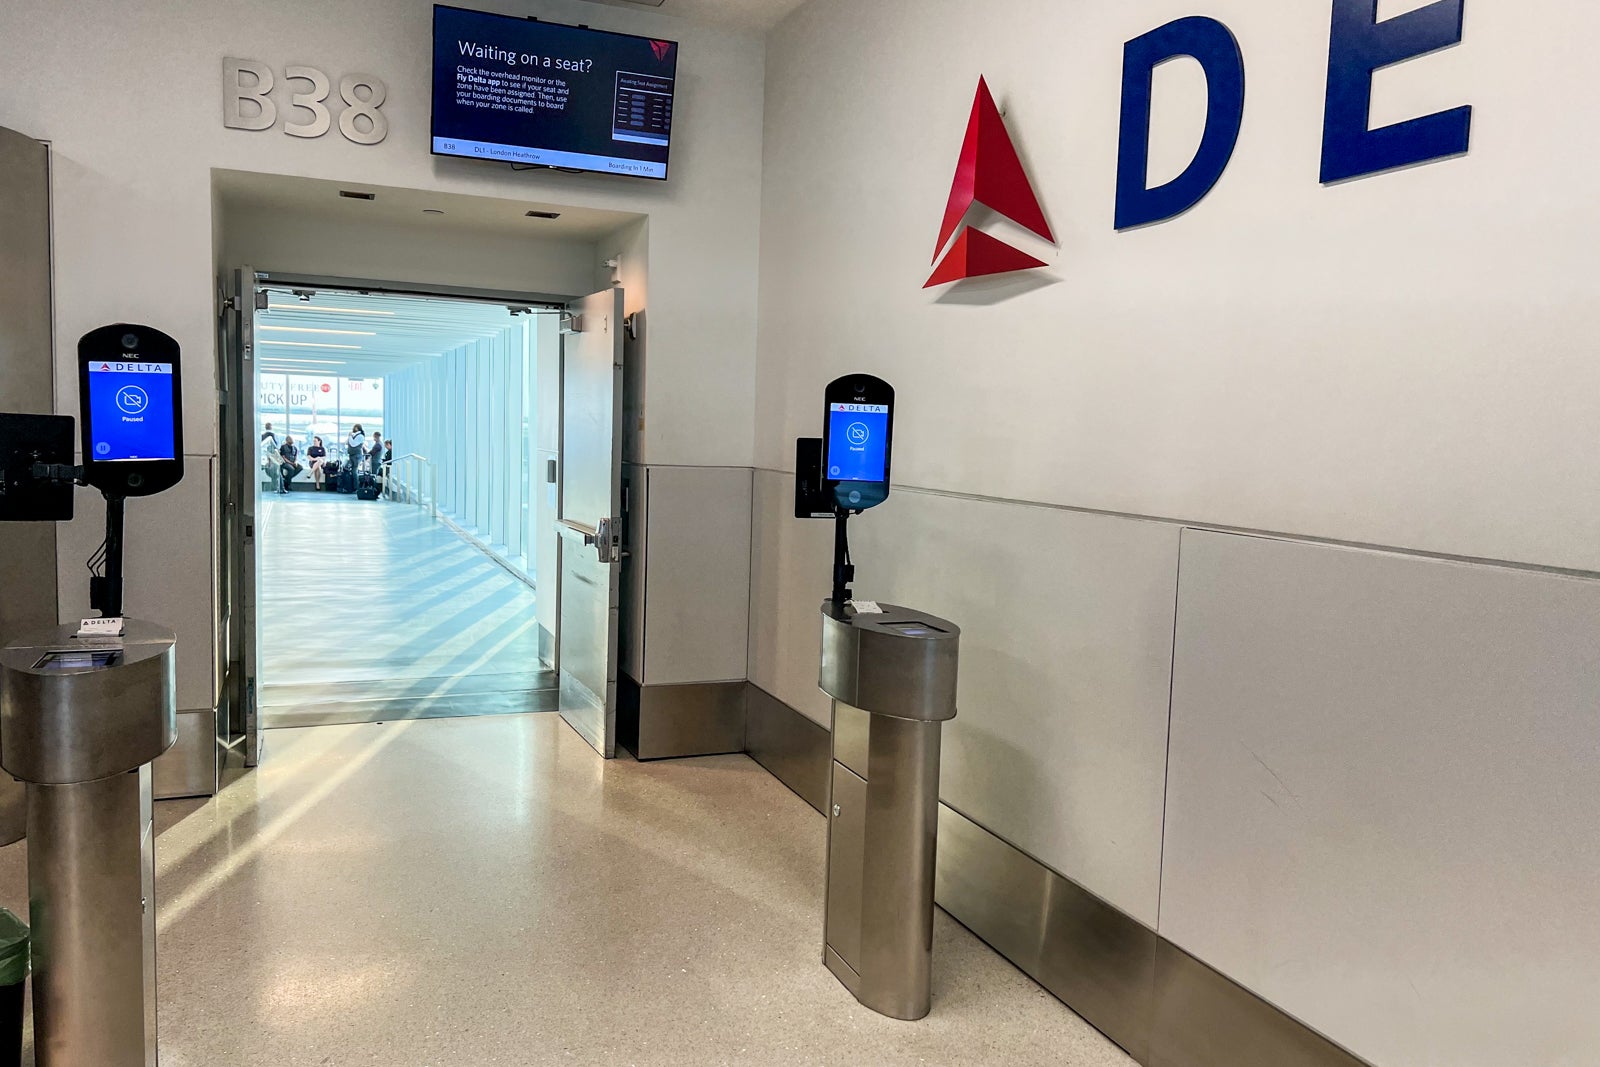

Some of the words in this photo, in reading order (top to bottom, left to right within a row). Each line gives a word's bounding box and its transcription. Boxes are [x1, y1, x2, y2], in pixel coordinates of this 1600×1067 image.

[458, 40, 516, 65] Waiting
[520, 53, 538, 66] on
[543, 57, 551, 67] a
[555, 57, 593, 73] seat?
[457, 65, 478, 75] Check
[491, 71, 520, 80] overhead
[521, 75, 546, 84] monitor
[457, 73, 467, 82] Fly
[468, 75, 487, 84] Delta
[457, 82, 473, 90] zone
[473, 83, 490, 92] have
[490, 86, 507, 94] been
[507, 89, 536, 98] assigned.
[537, 91, 555, 101] Then,
[223, 56, 388, 146] B38
[456, 98, 475, 106] when
[514, 106, 534, 114] called.
[472, 91, 501, 103] boarding
[501, 96, 537, 107] documents
[546, 101, 565, 110] board
[490, 149, 512, 157] London
[512, 152, 540, 160] Heathrow
[608, 162, 632, 171] Boarding
[116, 363, 162, 371] DELTA
[260, 381, 284, 391] UTY
[291, 394, 308, 406] UP
[848, 404, 881, 412] DELTA
